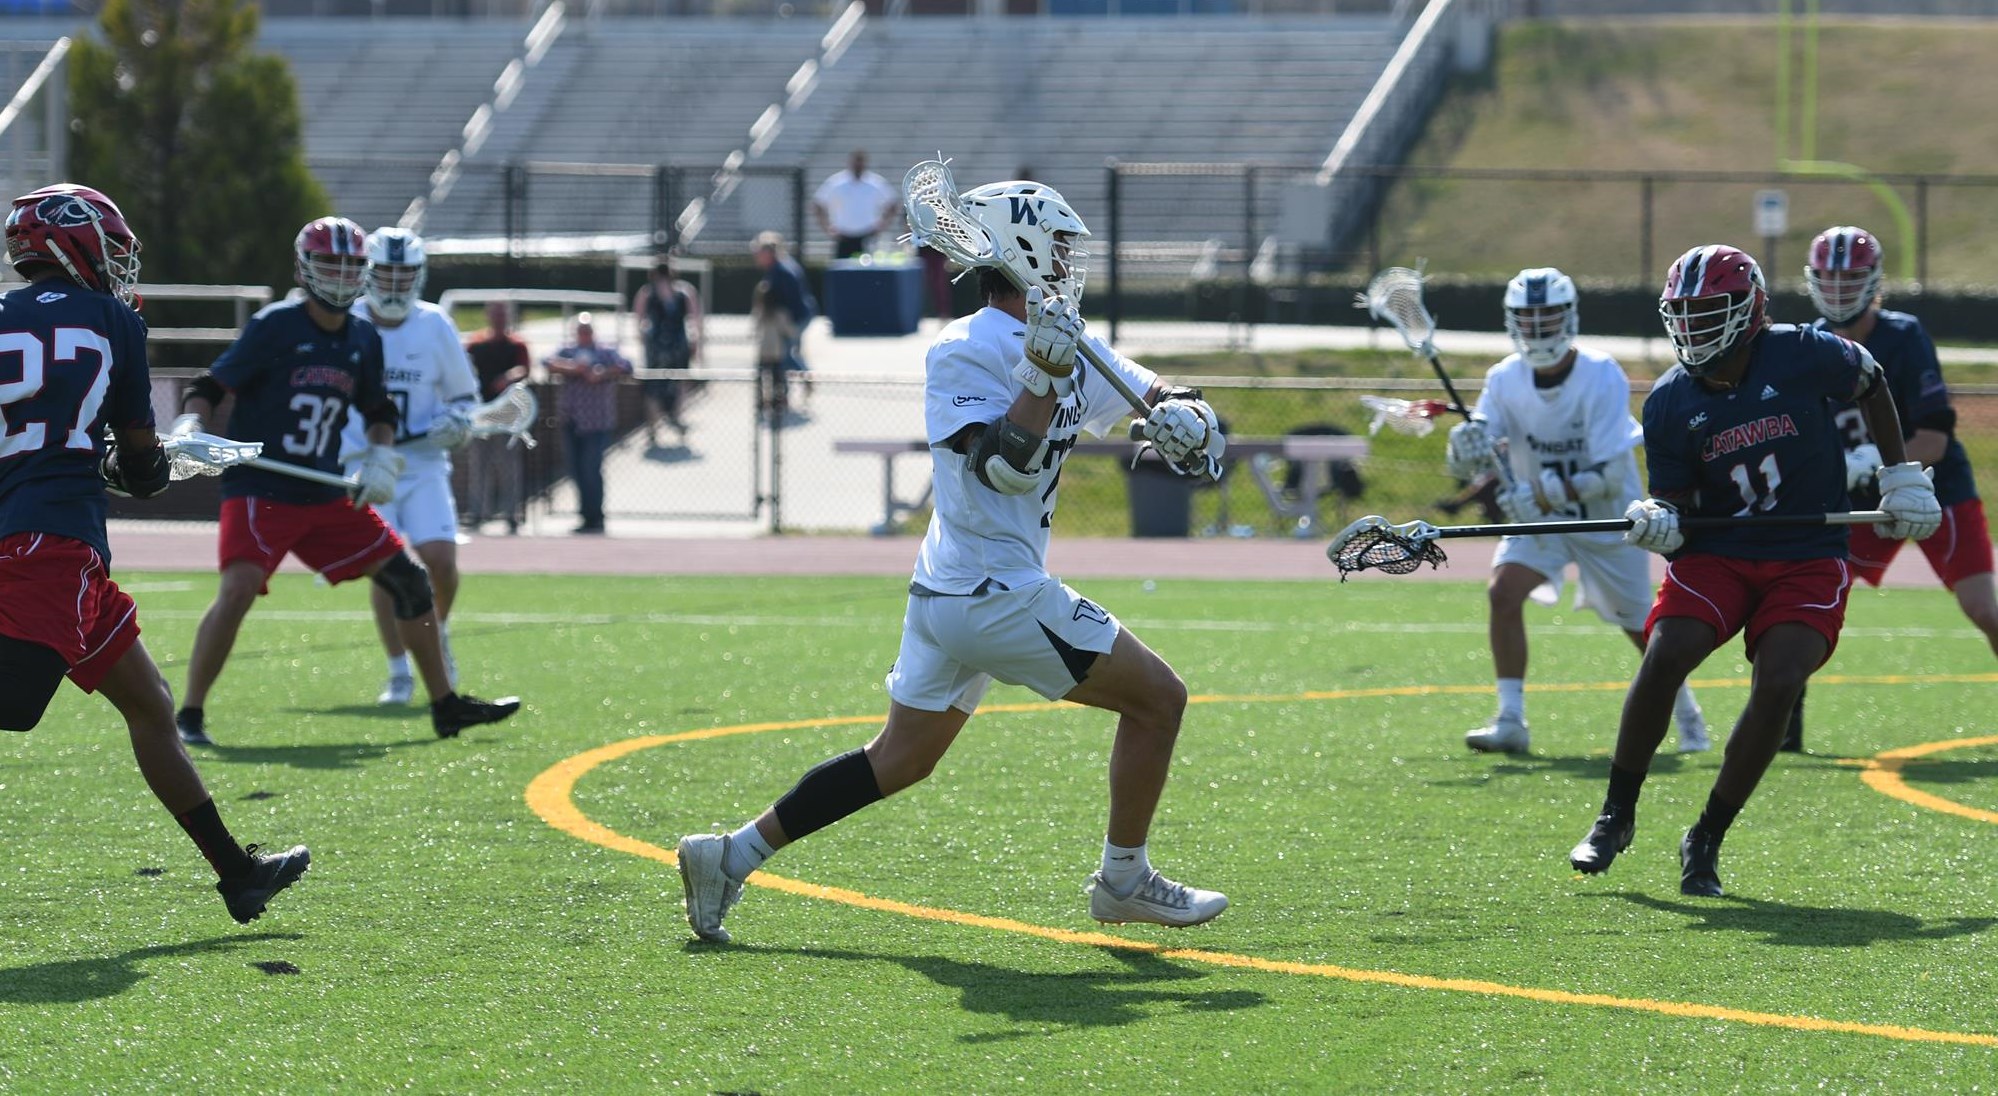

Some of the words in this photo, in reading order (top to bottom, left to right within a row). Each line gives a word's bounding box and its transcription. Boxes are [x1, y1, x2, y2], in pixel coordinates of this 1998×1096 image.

[1008, 196, 1045, 226] W
[0, 325, 115, 459] 27
[1688, 411, 1708, 429] SAC
[1702, 414, 1799, 462] CATAWBA
[1729, 452, 1782, 517] 11
